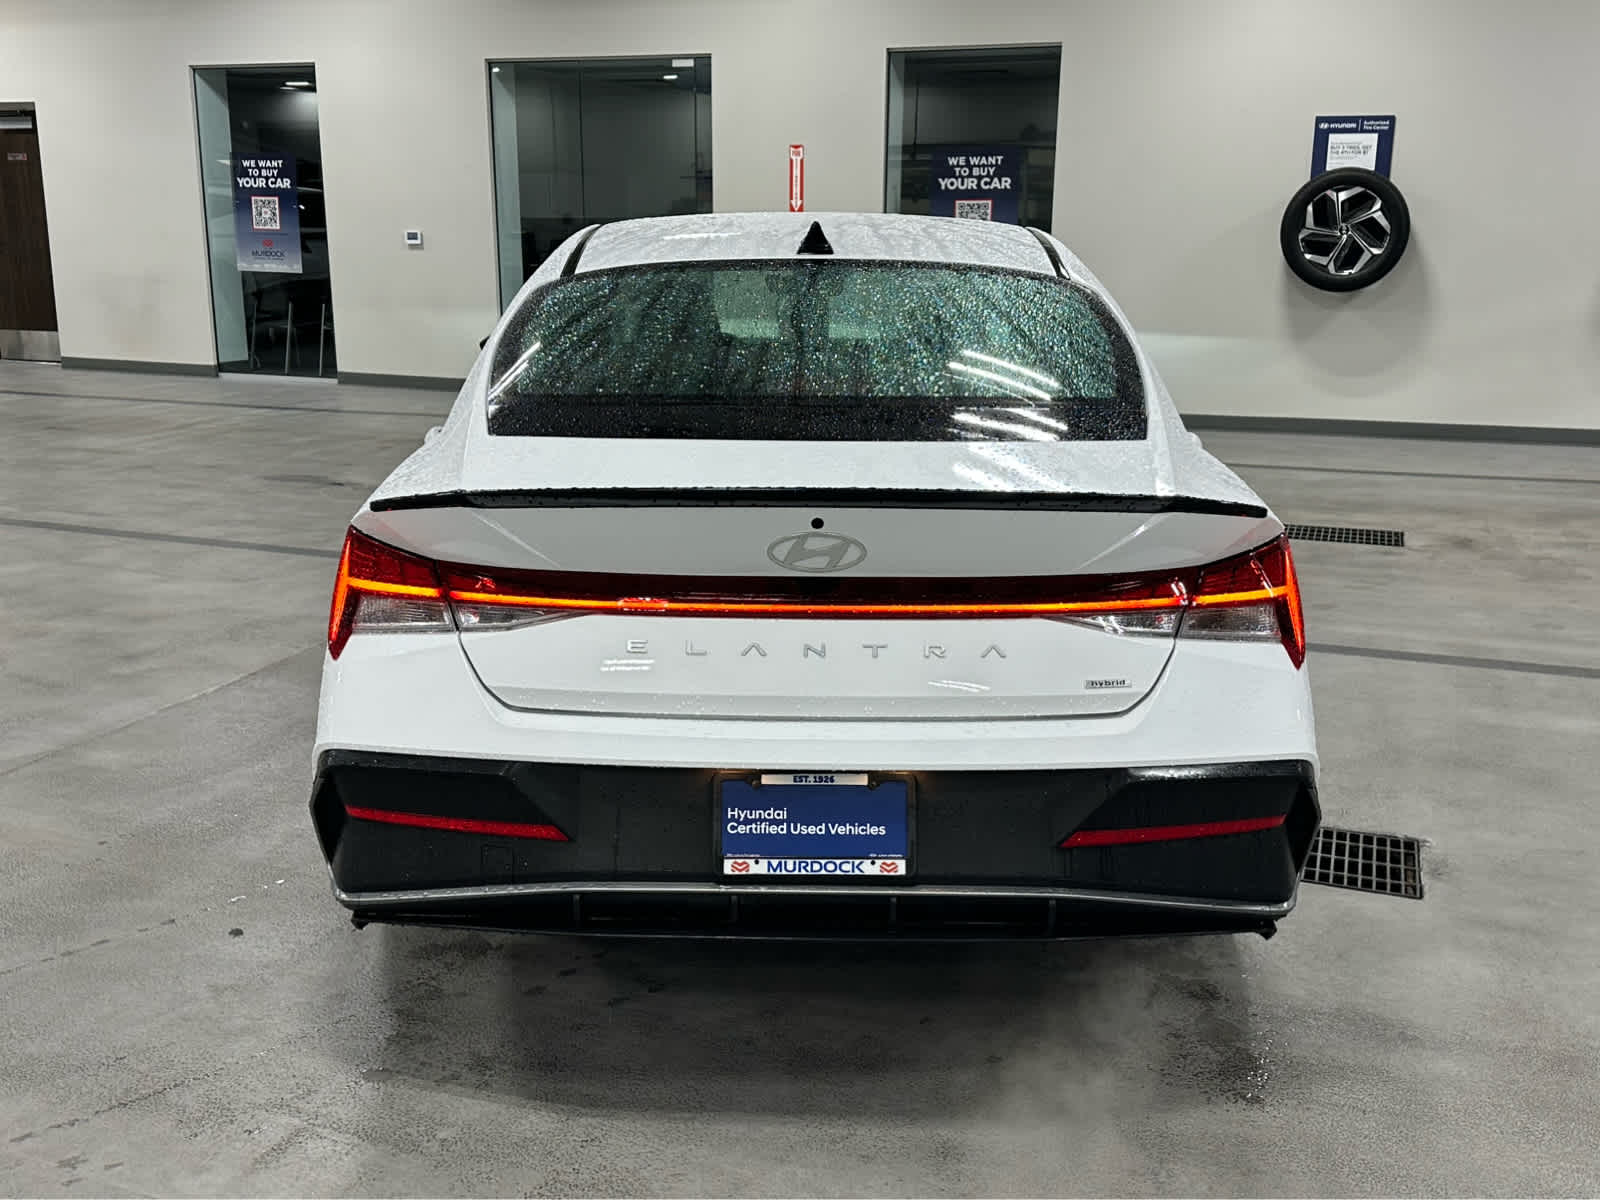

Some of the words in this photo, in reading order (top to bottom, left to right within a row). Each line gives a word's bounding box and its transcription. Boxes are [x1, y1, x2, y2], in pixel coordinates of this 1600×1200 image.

[241, 159, 256, 168] WE
[257, 159, 283, 168] WANT
[947, 156, 966, 166] WE
[969, 156, 1004, 166] WANT
[247, 168, 259, 177] TO
[261, 168, 278, 177] BUY
[954, 167, 969, 176] TO
[972, 167, 996, 176] BUY
[236, 177, 266, 188] YOUR
[267, 178, 291, 189] CAR
[938, 178, 978, 190] YOUR
[980, 177, 1012, 190] CAR
[626, 639, 1007, 660] ELANTRA
[1089, 679, 1126, 688] hybrid
[792, 775, 811, 783] EST.
[812, 775, 835, 783] 1926
[726, 807, 787, 821] Hyundai
[726, 822, 787, 834] Certified
[790, 823, 825, 835] Used
[828, 823, 886, 835] Vehicles
[766, 860, 865, 874] MURDOCK
